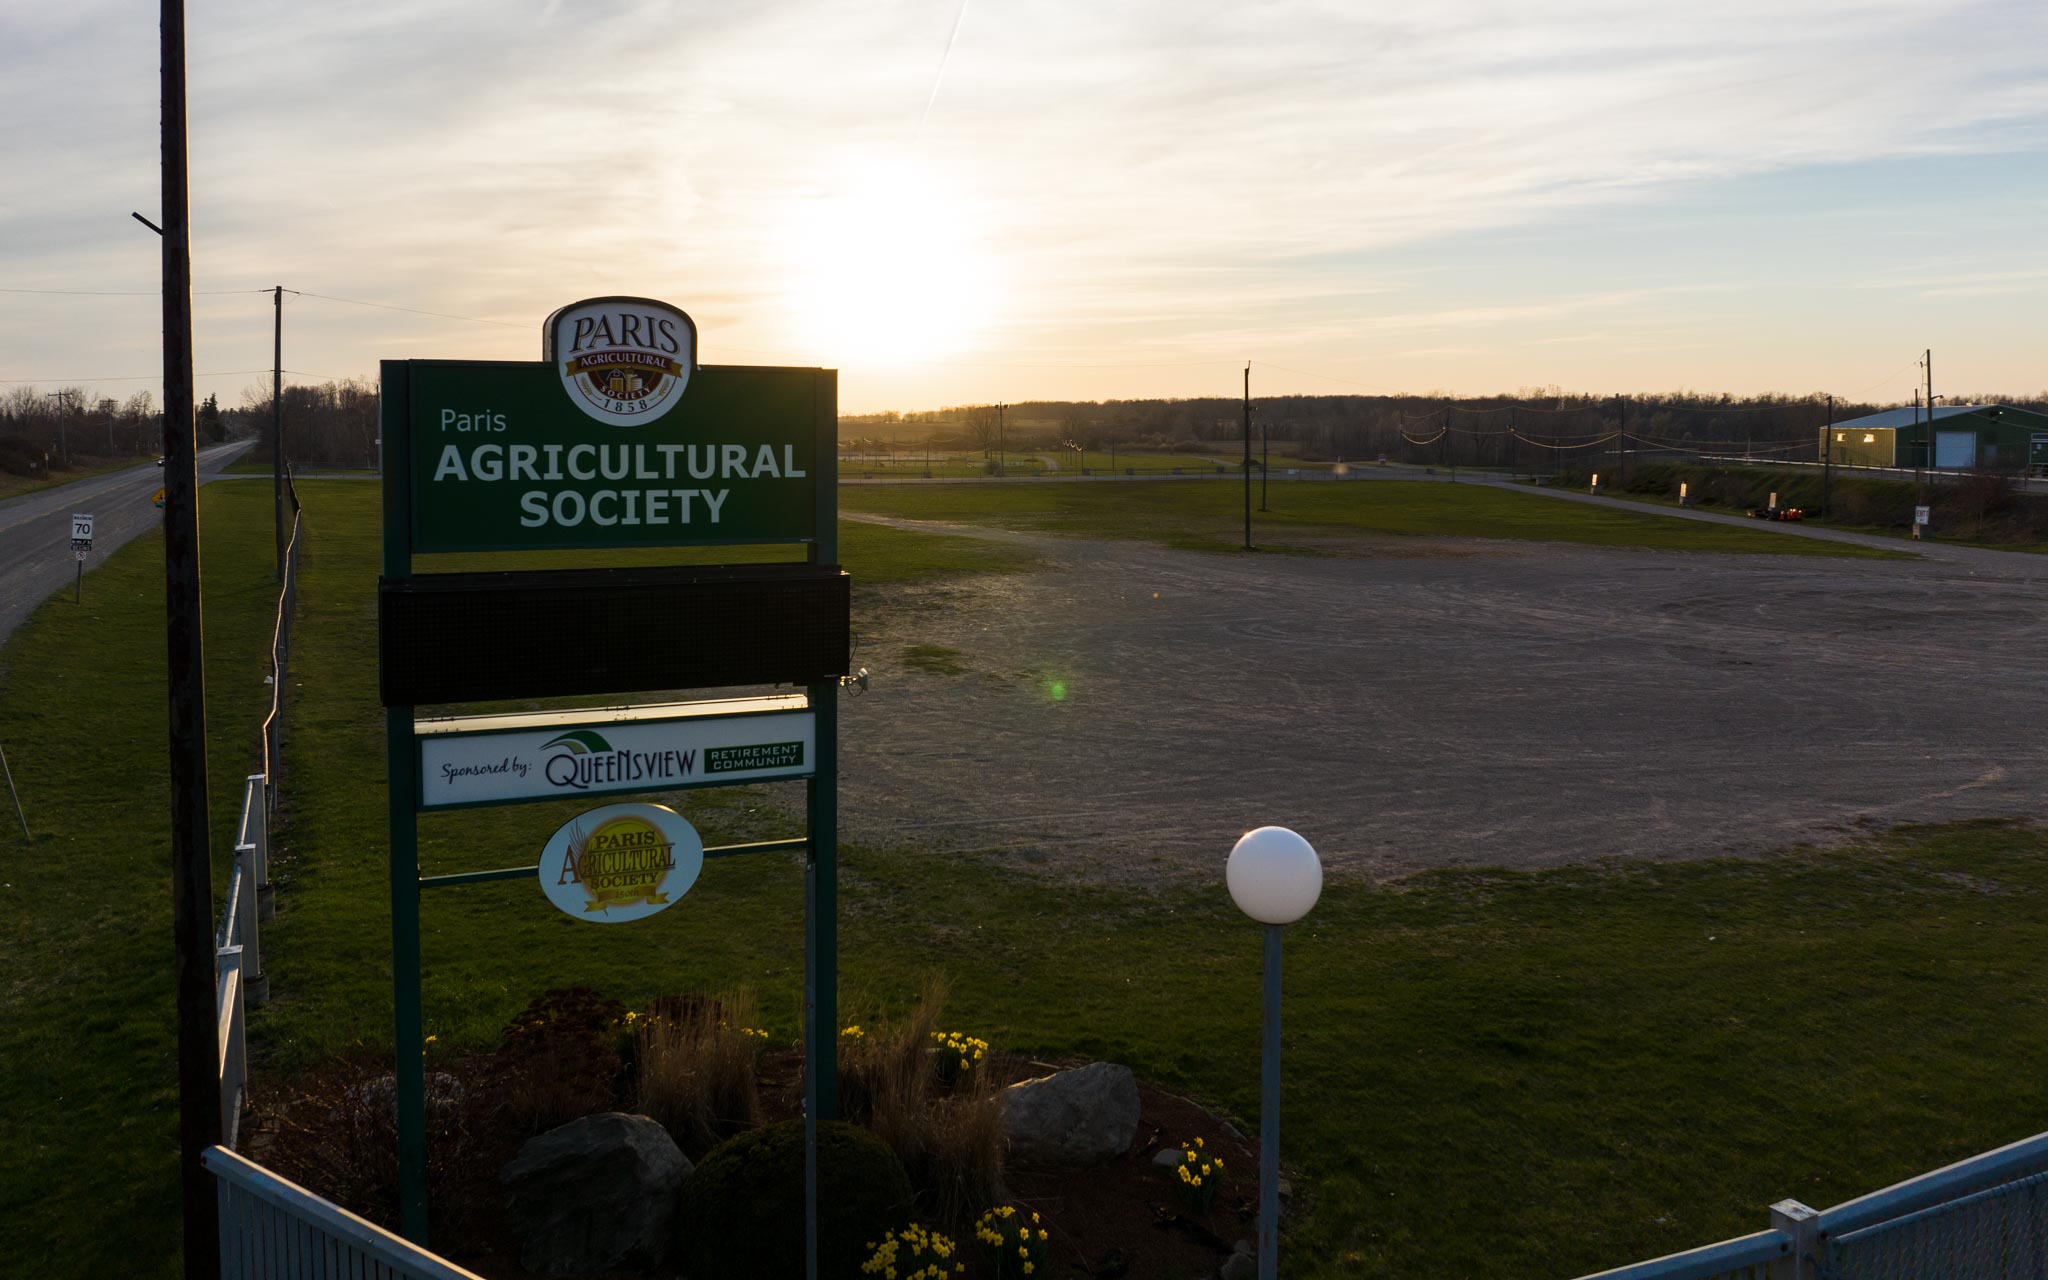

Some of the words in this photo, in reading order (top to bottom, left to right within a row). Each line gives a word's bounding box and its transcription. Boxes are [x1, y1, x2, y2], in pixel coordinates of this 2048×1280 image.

[570, 314, 680, 354] PARIS
[581, 353, 666, 368] AGRICULTURAL
[601, 386, 651, 399] SOCIETY
[604, 399, 647, 412] 1858
[440, 408, 507, 432] Paris
[433, 443, 806, 482] AGRICULTURAL
[519, 489, 730, 528] SOCIETY
[74, 523, 91, 535] 70
[710, 744, 799, 761] RETIREMENT
[441, 757, 509, 784] Sponsored
[512, 757, 532, 776] by:
[712, 755, 797, 770] COMMUNITY
[595, 830, 656, 849] PARIS
[591, 870, 659, 889] SOCIETY
